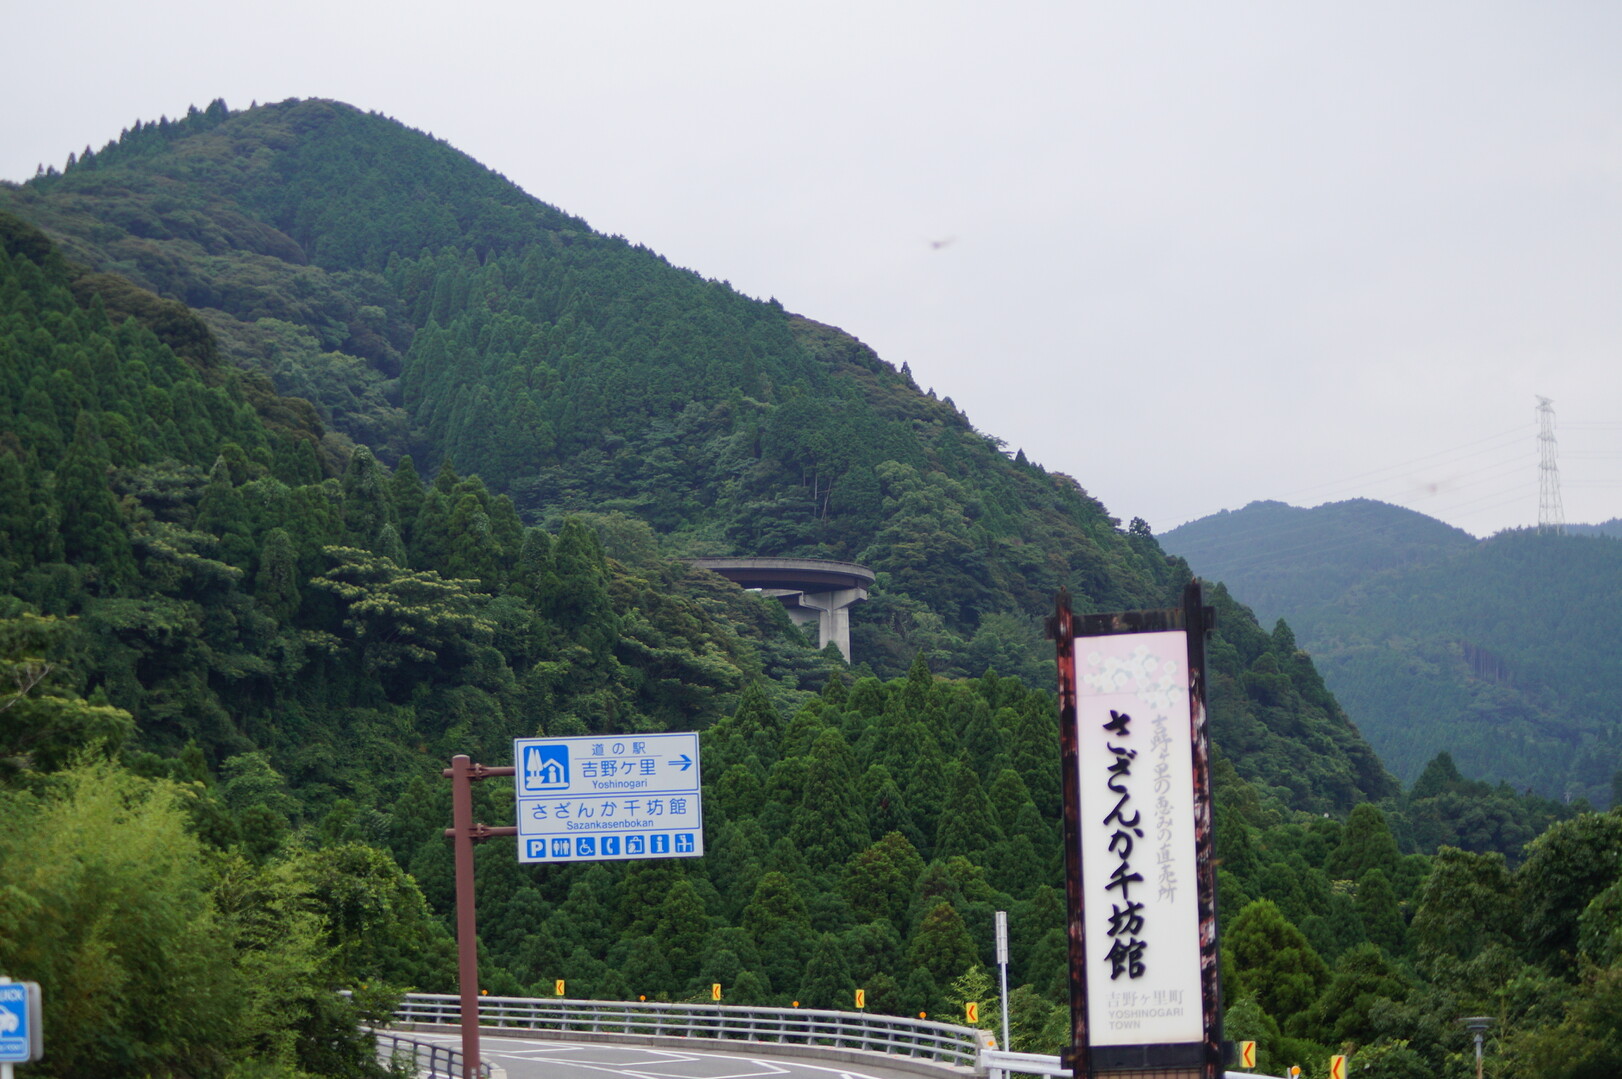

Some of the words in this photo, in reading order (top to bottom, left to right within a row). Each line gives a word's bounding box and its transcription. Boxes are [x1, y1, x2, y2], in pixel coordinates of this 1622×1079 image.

[592, 742, 646, 756] 道の駅
[592, 779, 648, 790] Yoshinogari
[532, 798, 687, 820] さざんか千坊館
[566, 819, 654, 830] Sazankasenbokan
[1102, 709, 1149, 981] さざんか千坊館
[1108, 1007, 1184, 1019] YOSHINOGARI
[1108, 1020, 1141, 1030] TOWN
